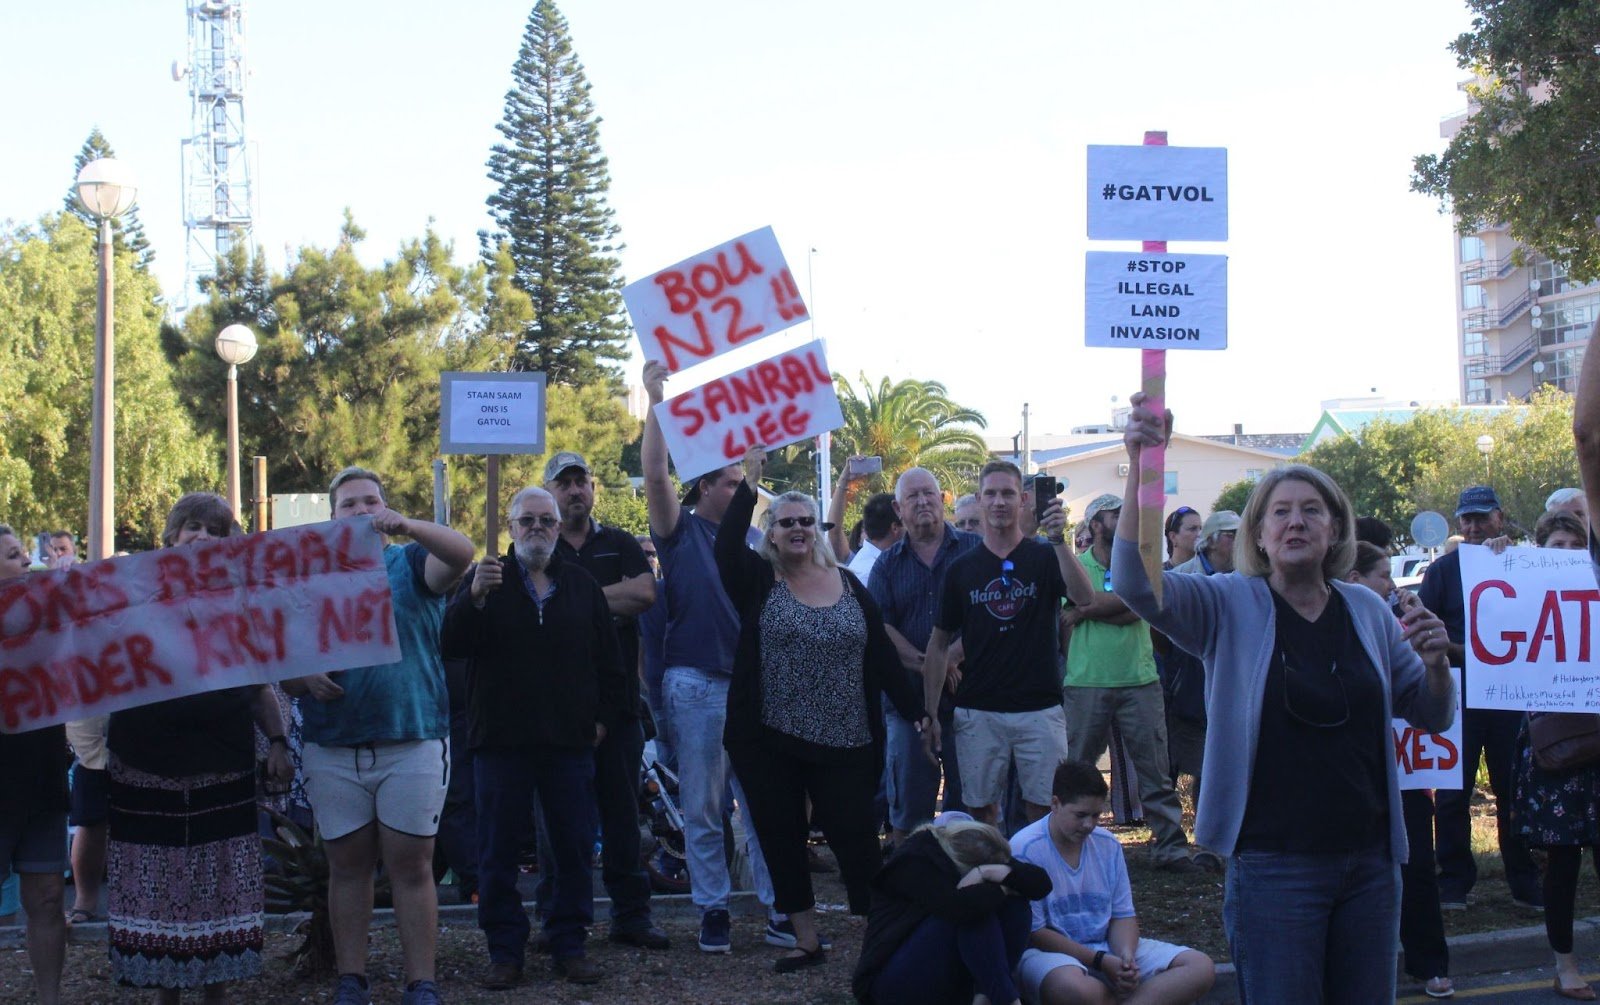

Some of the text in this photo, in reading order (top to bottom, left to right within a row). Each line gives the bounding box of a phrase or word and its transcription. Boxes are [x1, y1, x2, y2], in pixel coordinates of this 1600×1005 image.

[1102, 184, 1214, 202] #GATVOL
[1127, 260, 1186, 273] #STOP
[654, 242, 764, 314] BOU
[1118, 282, 1195, 296] ILLEGAL
[1131, 305, 1180, 318] LAND
[654, 297, 764, 372] N2
[1110, 326, 1200, 340] INVASION
[467, 391, 522, 400] STAAN SAAM
[670, 351, 834, 437] SANRAL
[481, 405, 508, 413] ONS IS
[477, 418, 511, 426] GATVOL
[723, 403, 811, 459] LIEG
[1470, 579, 1600, 665] GAT
[0, 633, 172, 730] ANDER
[186, 608, 284, 676] KRY
